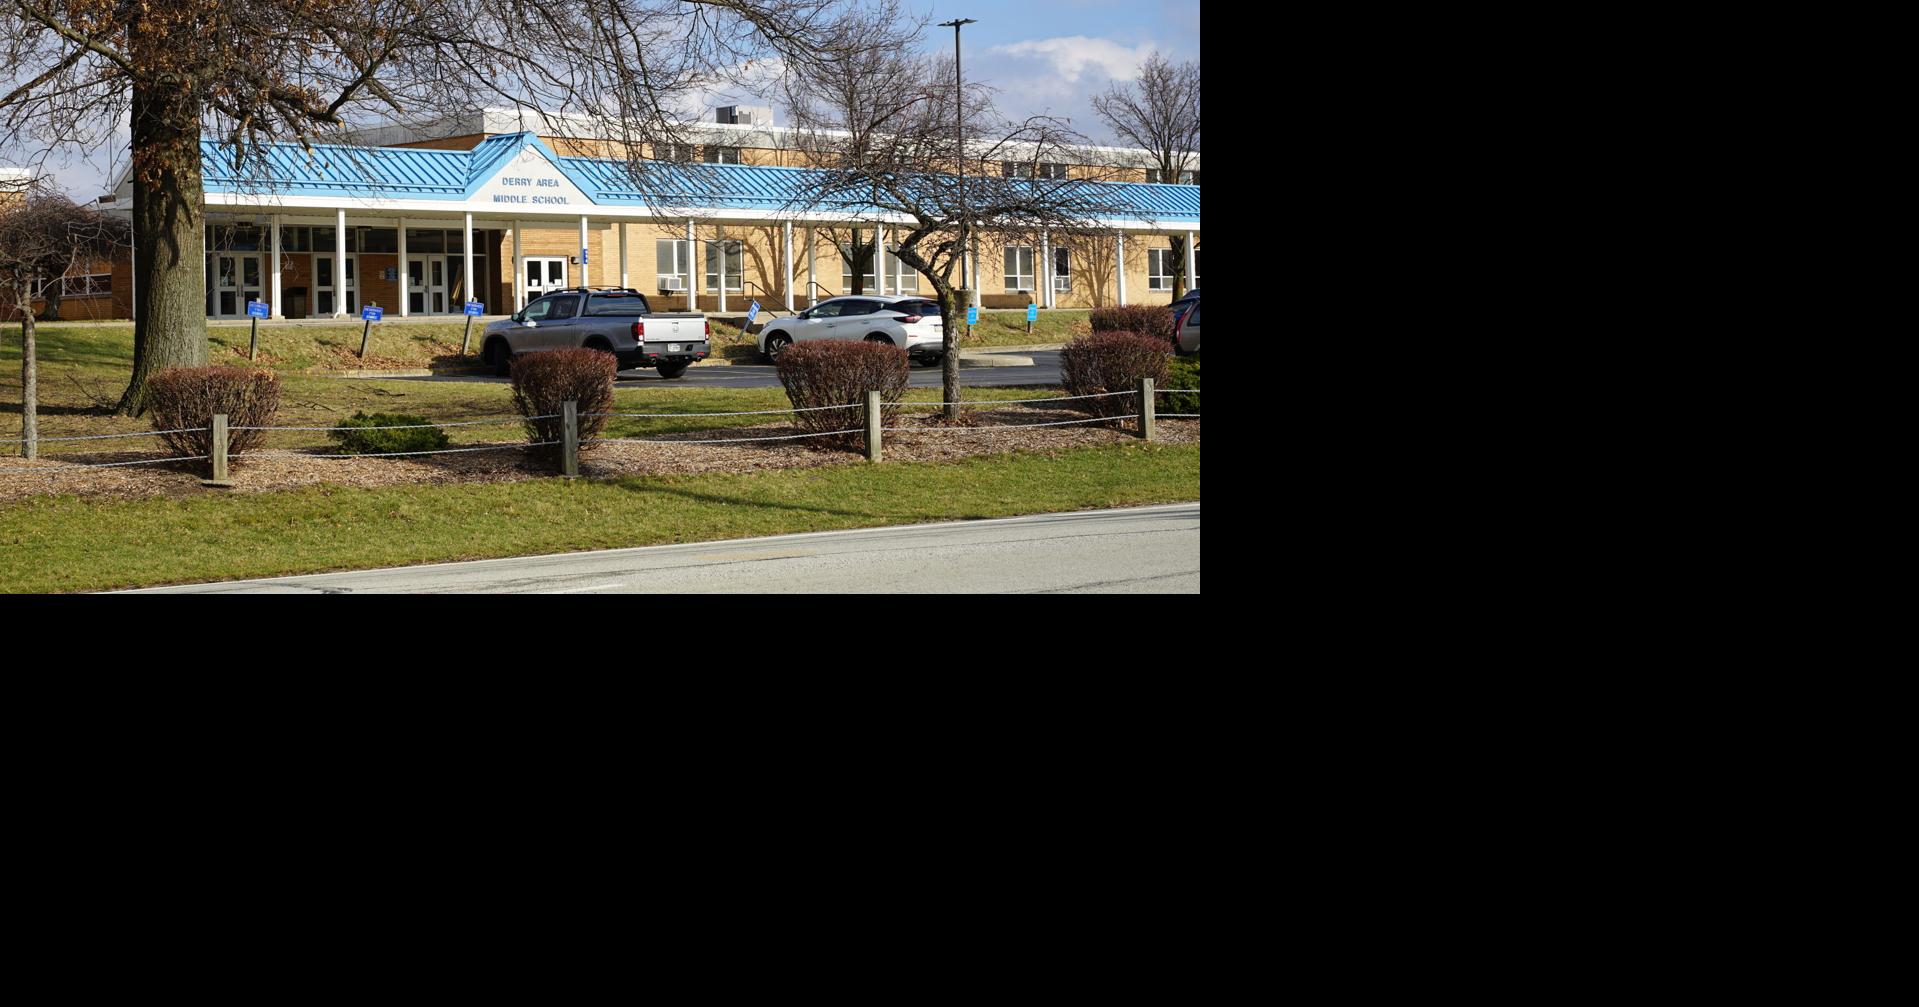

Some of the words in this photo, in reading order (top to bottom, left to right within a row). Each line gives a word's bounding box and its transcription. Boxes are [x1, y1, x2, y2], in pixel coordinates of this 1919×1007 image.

[502, 177, 532, 186] DERRY
[536, 178, 559, 187] AREA
[493, 194, 527, 203] MIDDLE
[532, 196, 569, 205] SCHOOL
